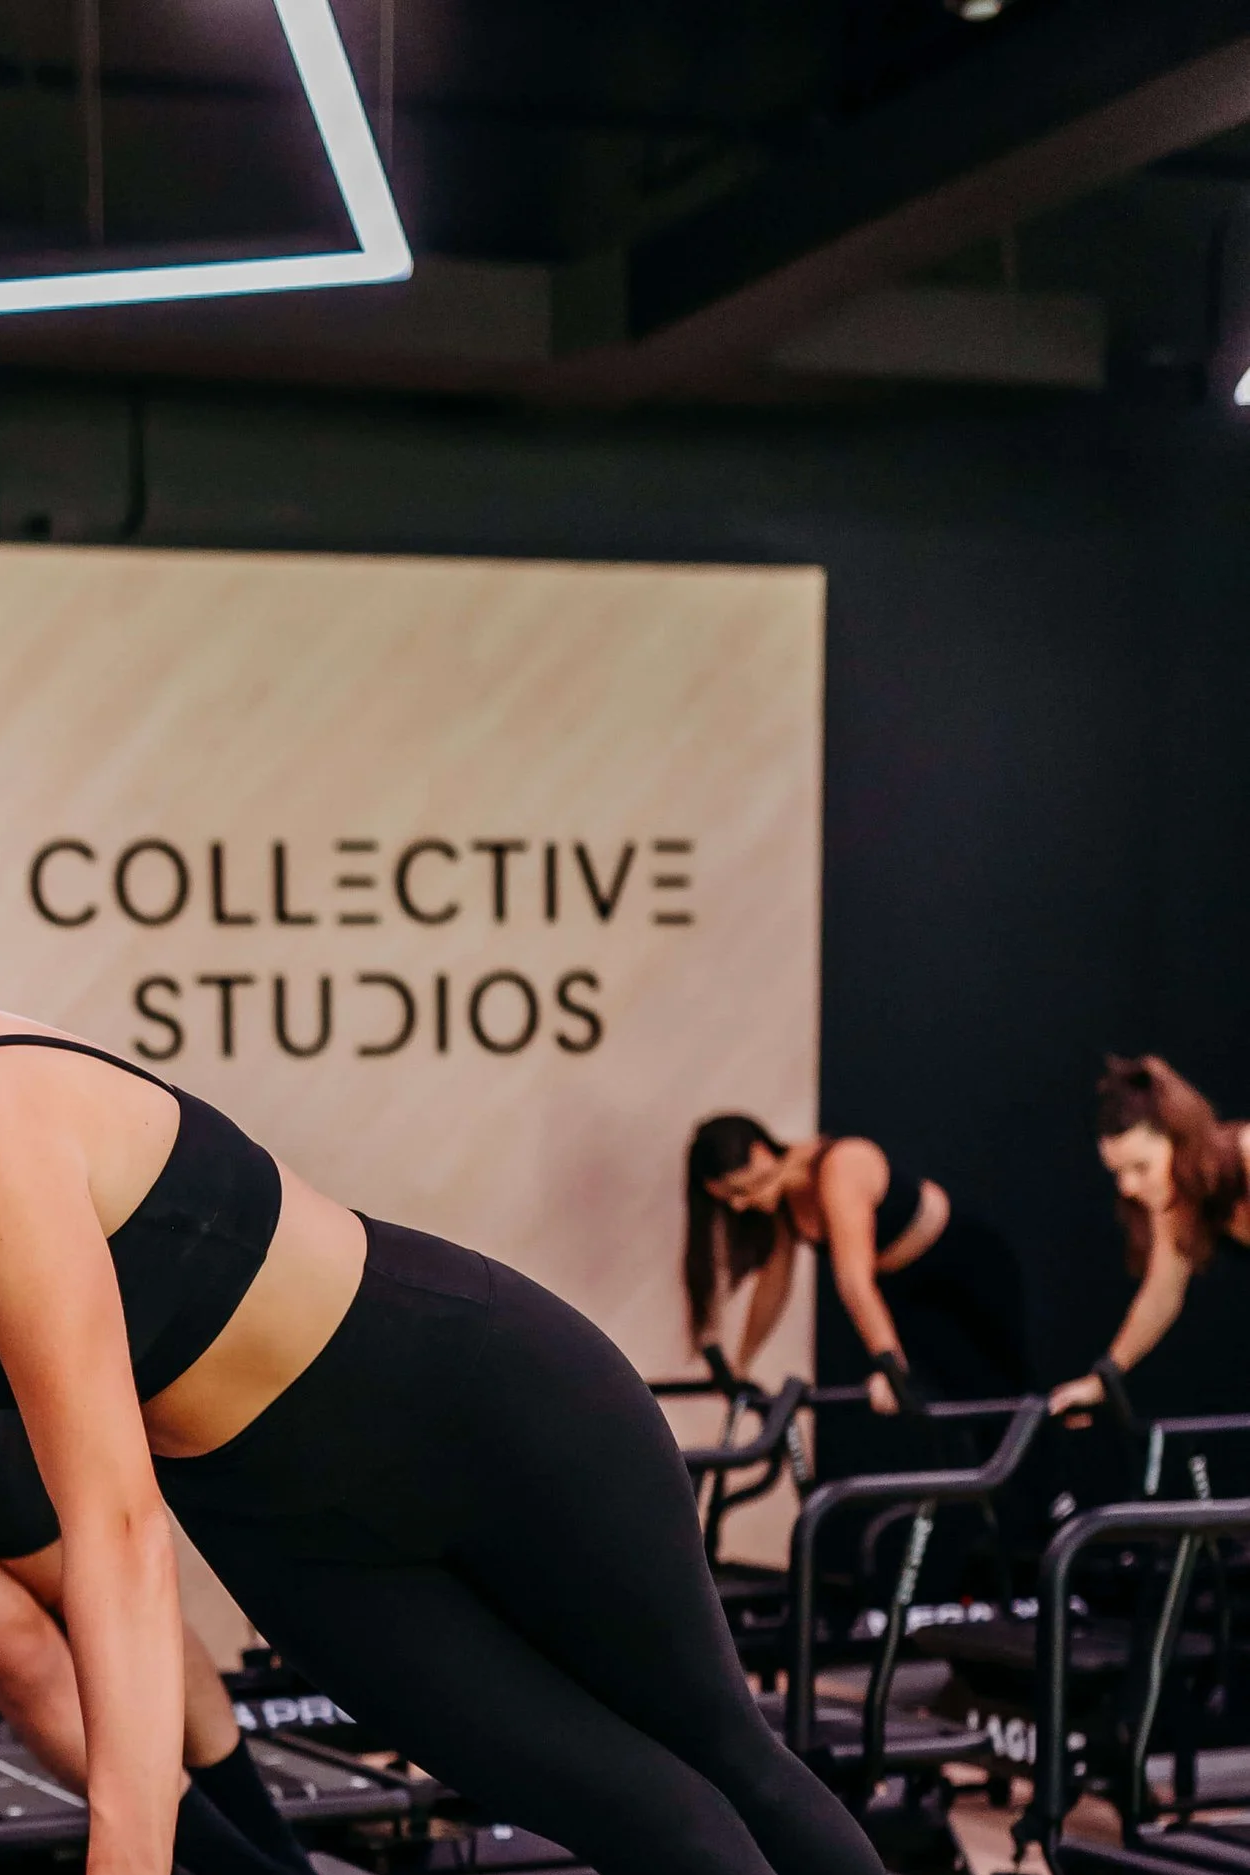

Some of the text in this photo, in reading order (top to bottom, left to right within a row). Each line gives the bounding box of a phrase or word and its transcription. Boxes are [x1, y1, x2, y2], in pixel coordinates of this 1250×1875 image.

[27, 838, 696, 928] COLLECTIVE
[131, 969, 604, 1061] STUDIOS
[261, 1695, 356, 1728] PR
